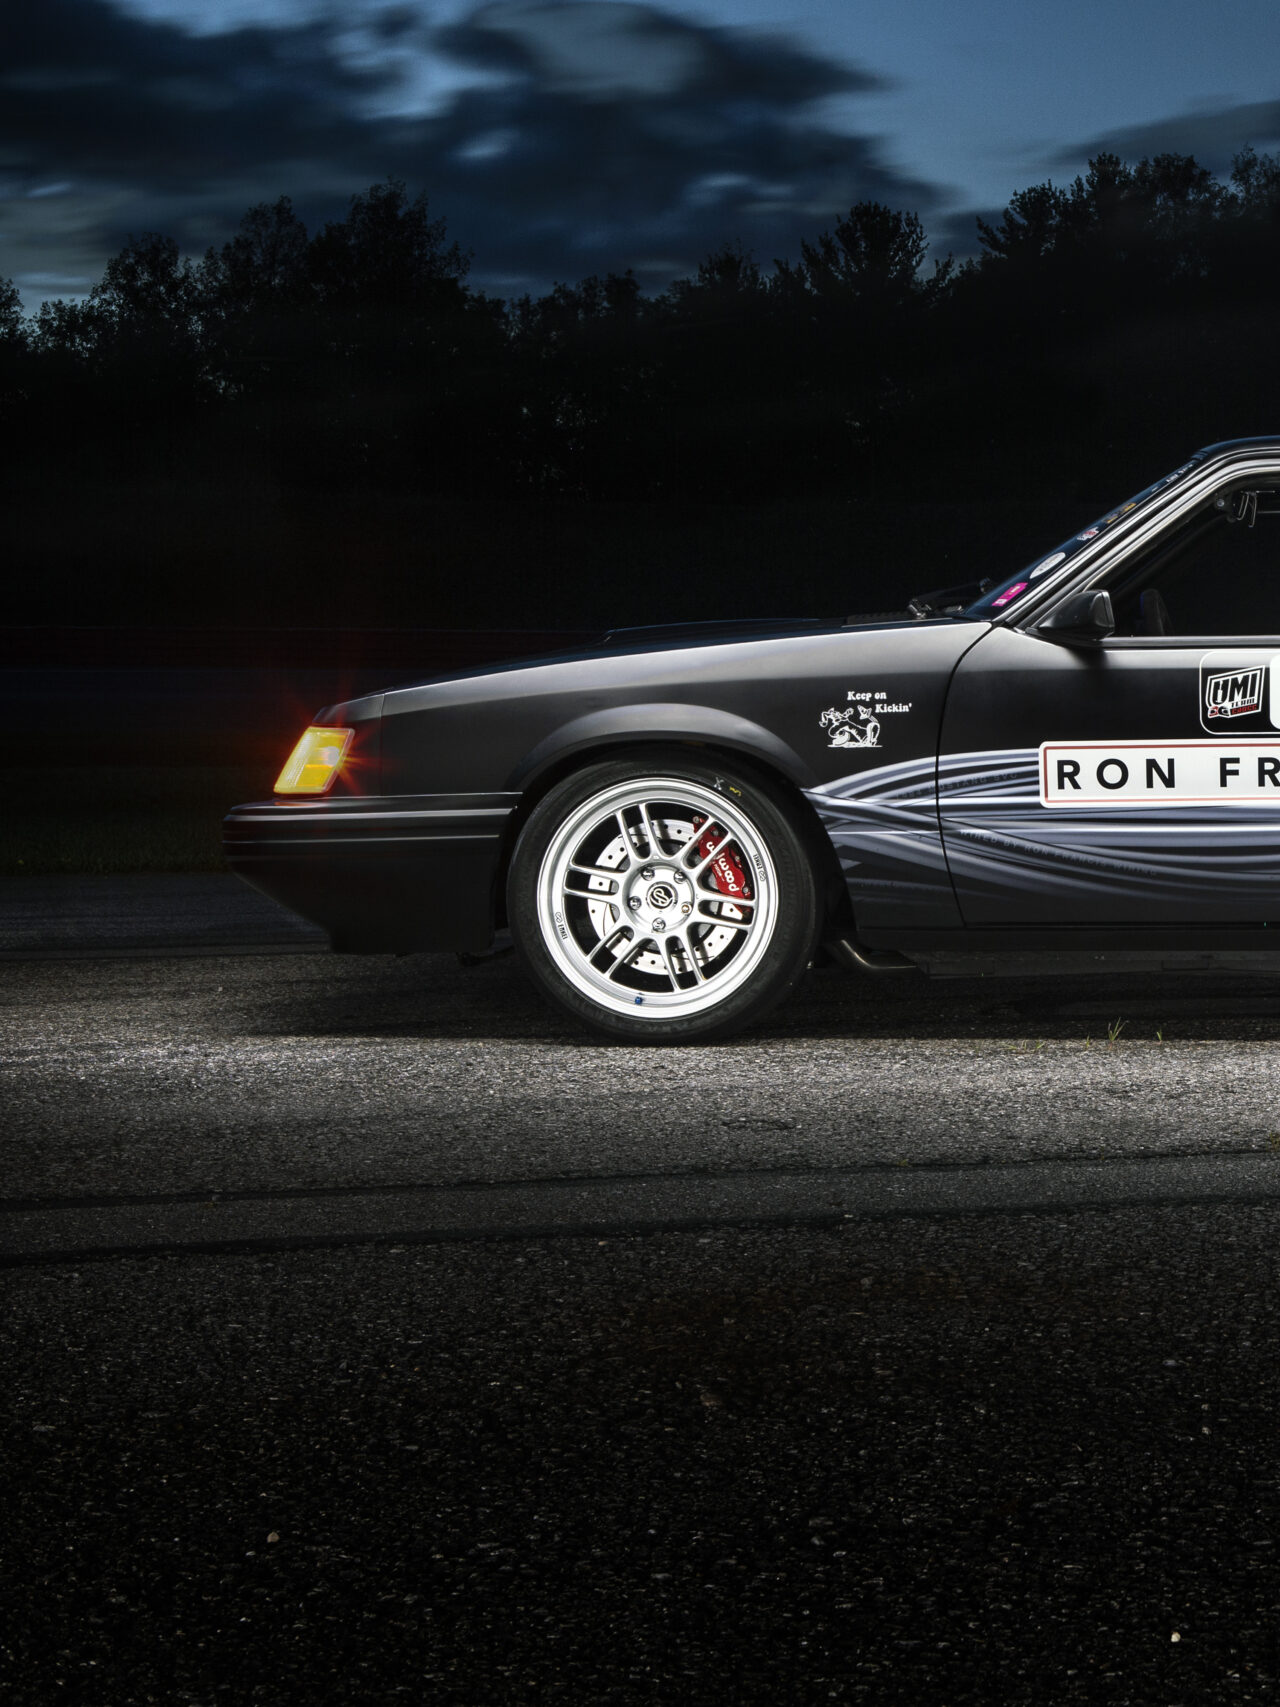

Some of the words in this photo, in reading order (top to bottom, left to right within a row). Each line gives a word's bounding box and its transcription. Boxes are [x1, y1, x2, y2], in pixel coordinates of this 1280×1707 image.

[847, 691, 872, 701] Keep
[874, 692, 887, 700] on
[1212, 672, 1258, 705] UMI
[875, 703, 912, 713] Kickin'
[993, 772, 1017, 782] SVO
[1056, 758, 1176, 790] RON
[705, 840, 741, 892] wlwood
